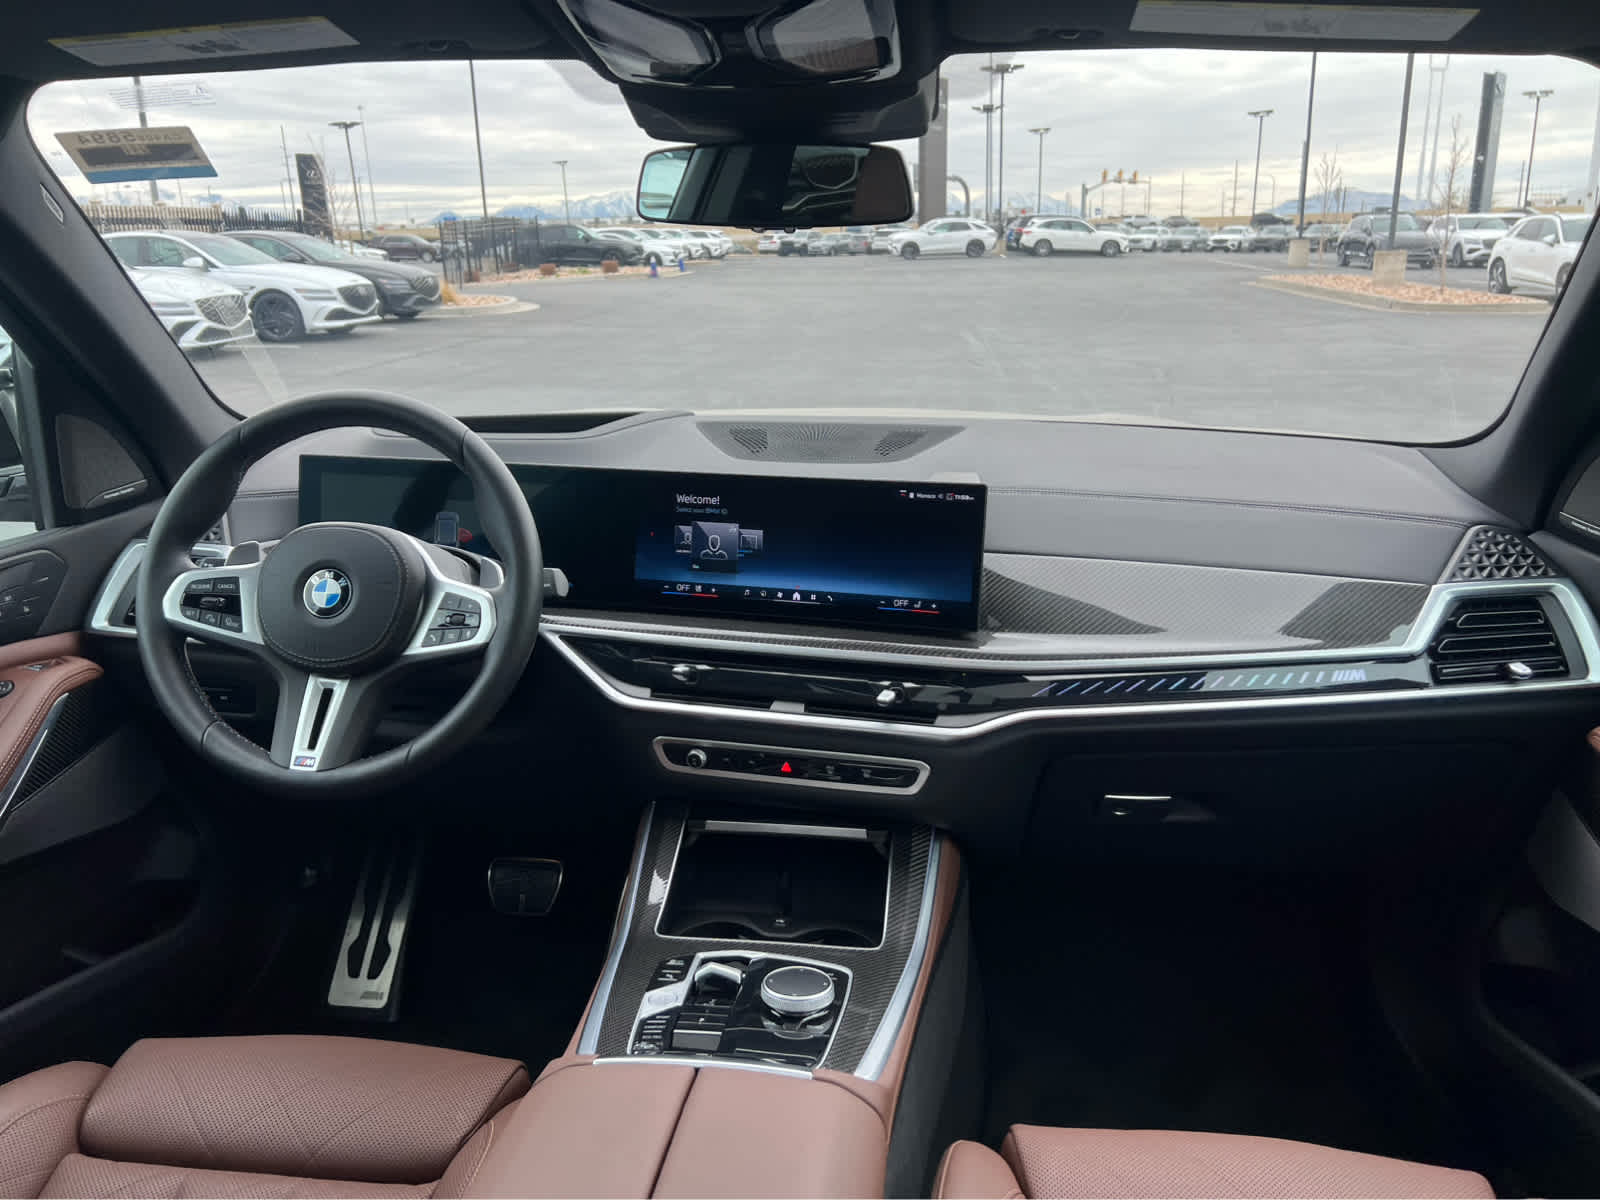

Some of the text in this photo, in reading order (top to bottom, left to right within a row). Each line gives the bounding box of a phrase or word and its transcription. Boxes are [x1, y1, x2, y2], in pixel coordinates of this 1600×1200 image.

[676, 493, 720, 505] Welcome!
[310, 571, 348, 587] BMW
[676, 583, 691, 592] OFF
[893, 599, 909, 608] OFF
